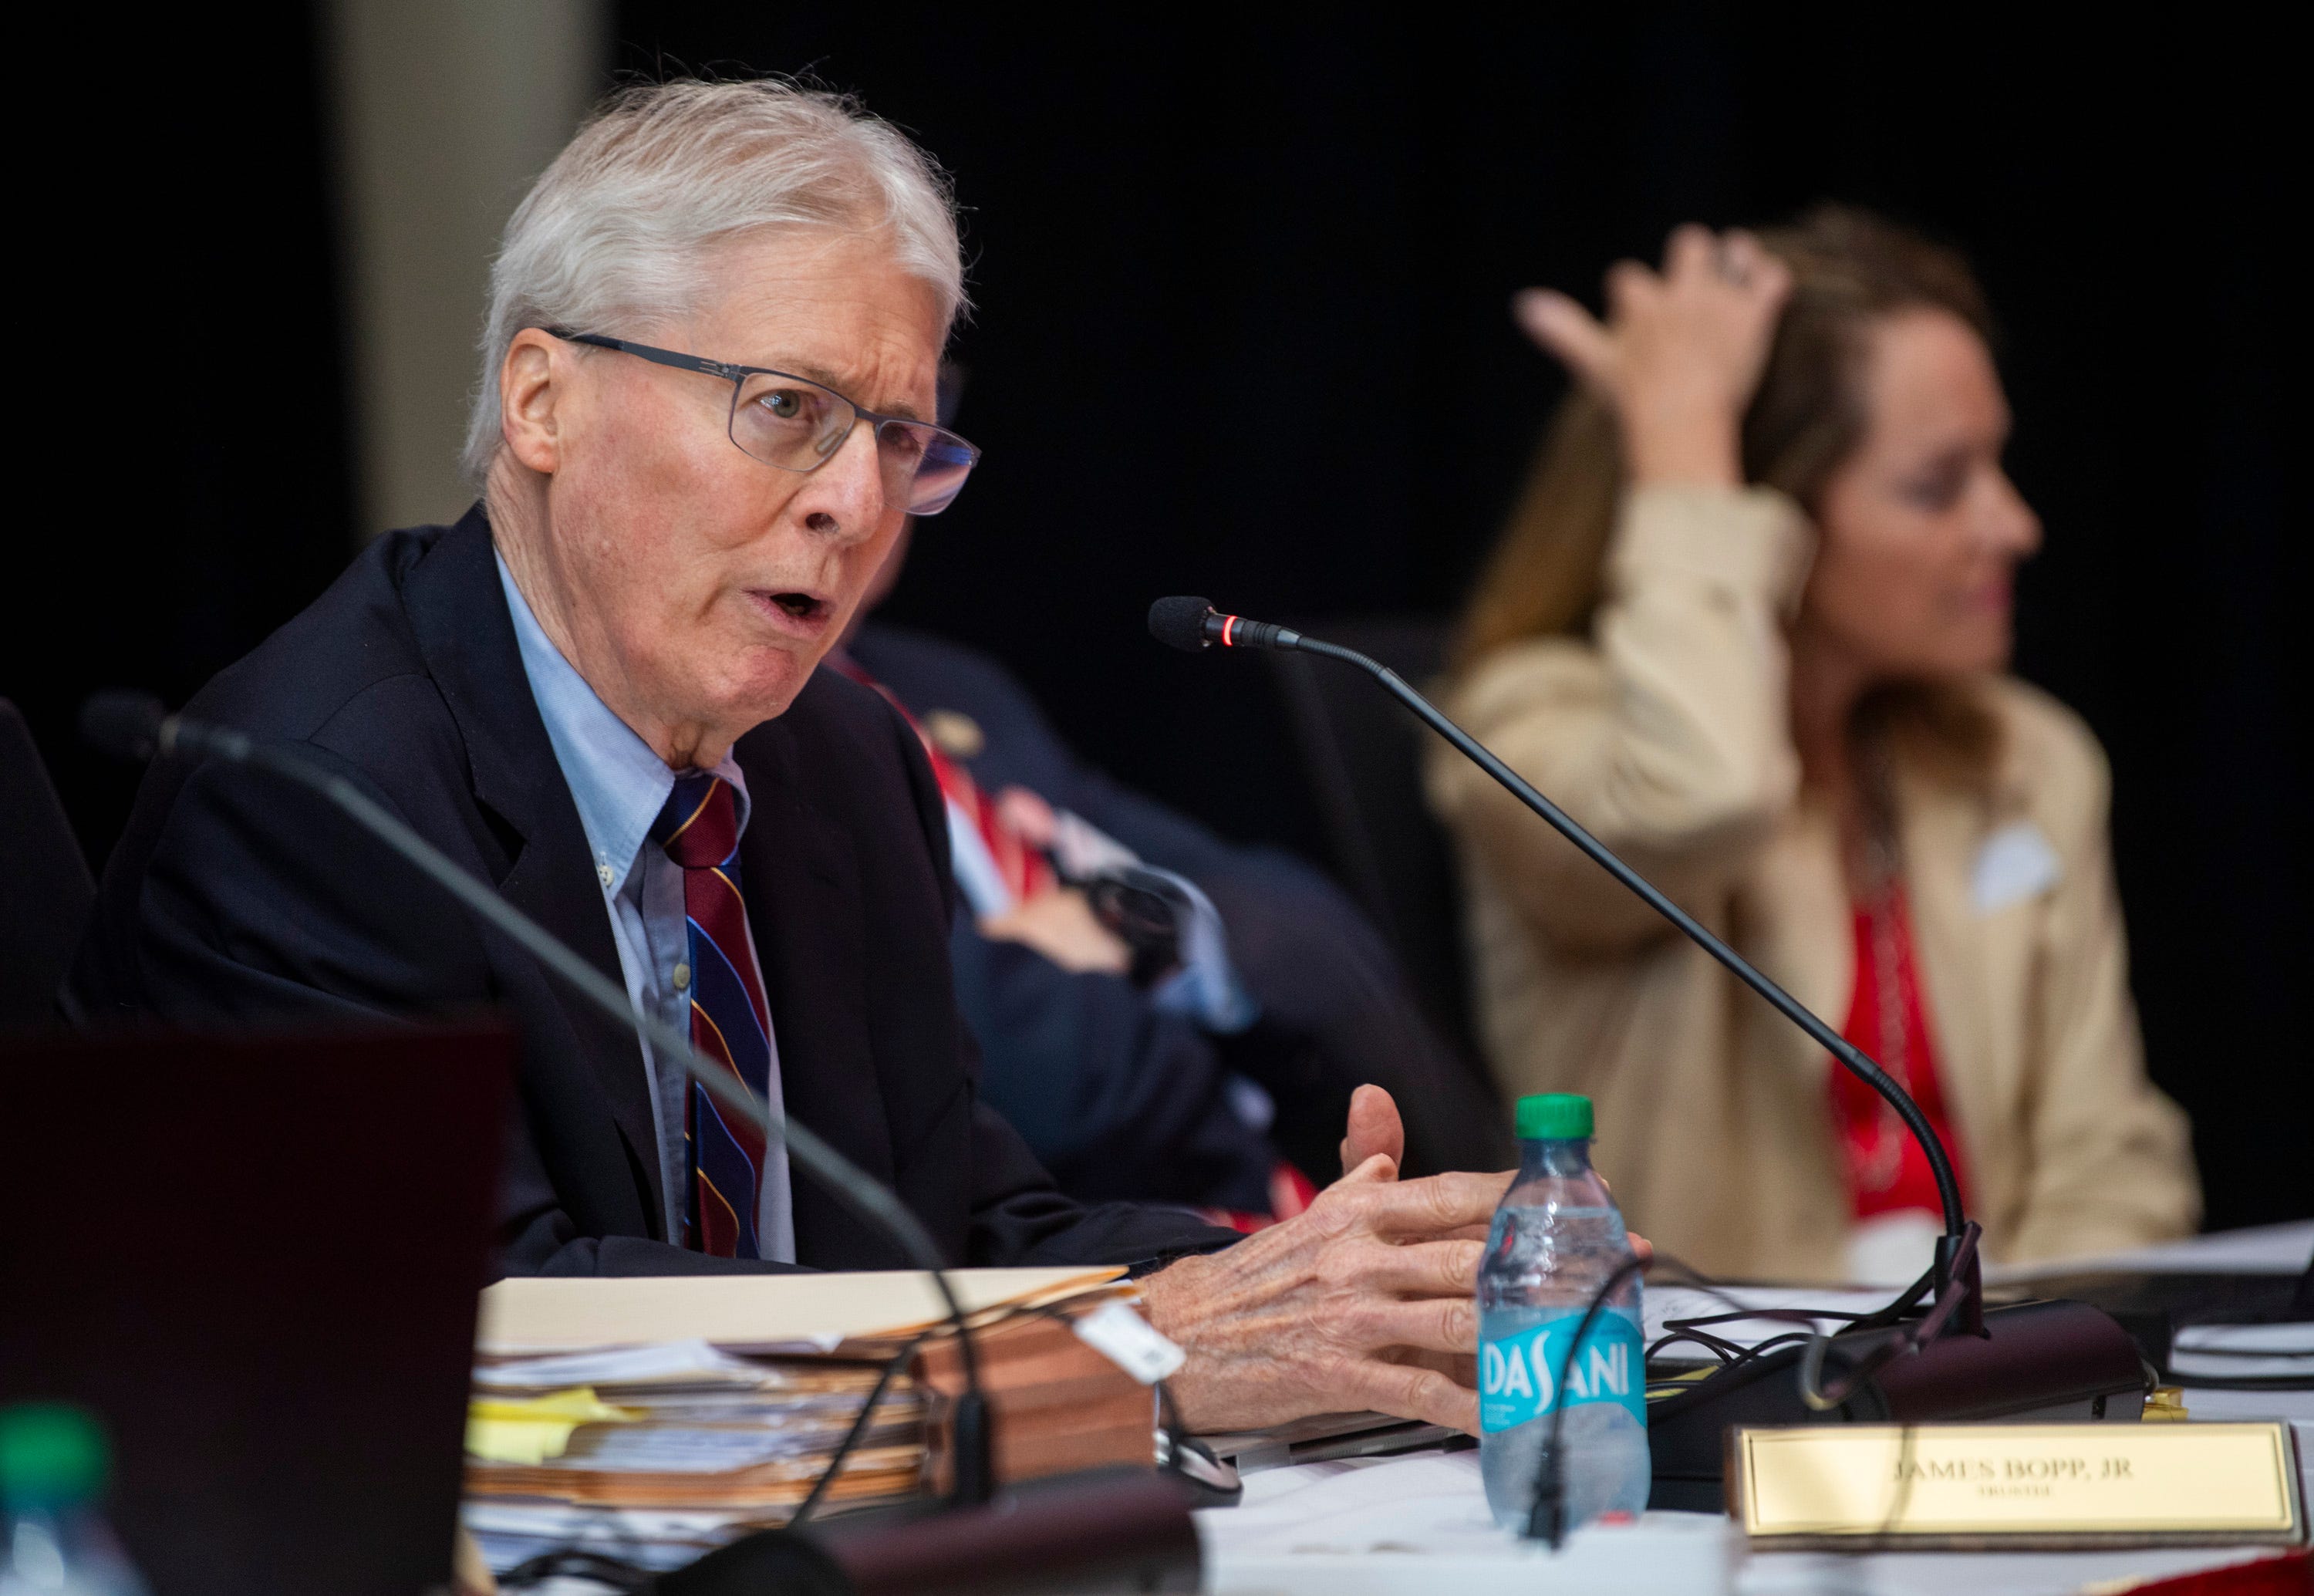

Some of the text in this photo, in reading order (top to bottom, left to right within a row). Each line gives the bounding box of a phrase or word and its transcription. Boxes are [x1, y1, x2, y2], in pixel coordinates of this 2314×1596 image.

[1483, 1331, 1629, 1415] DASANI
[1894, 1457, 2135, 1482] JAMES BOPP, JR
